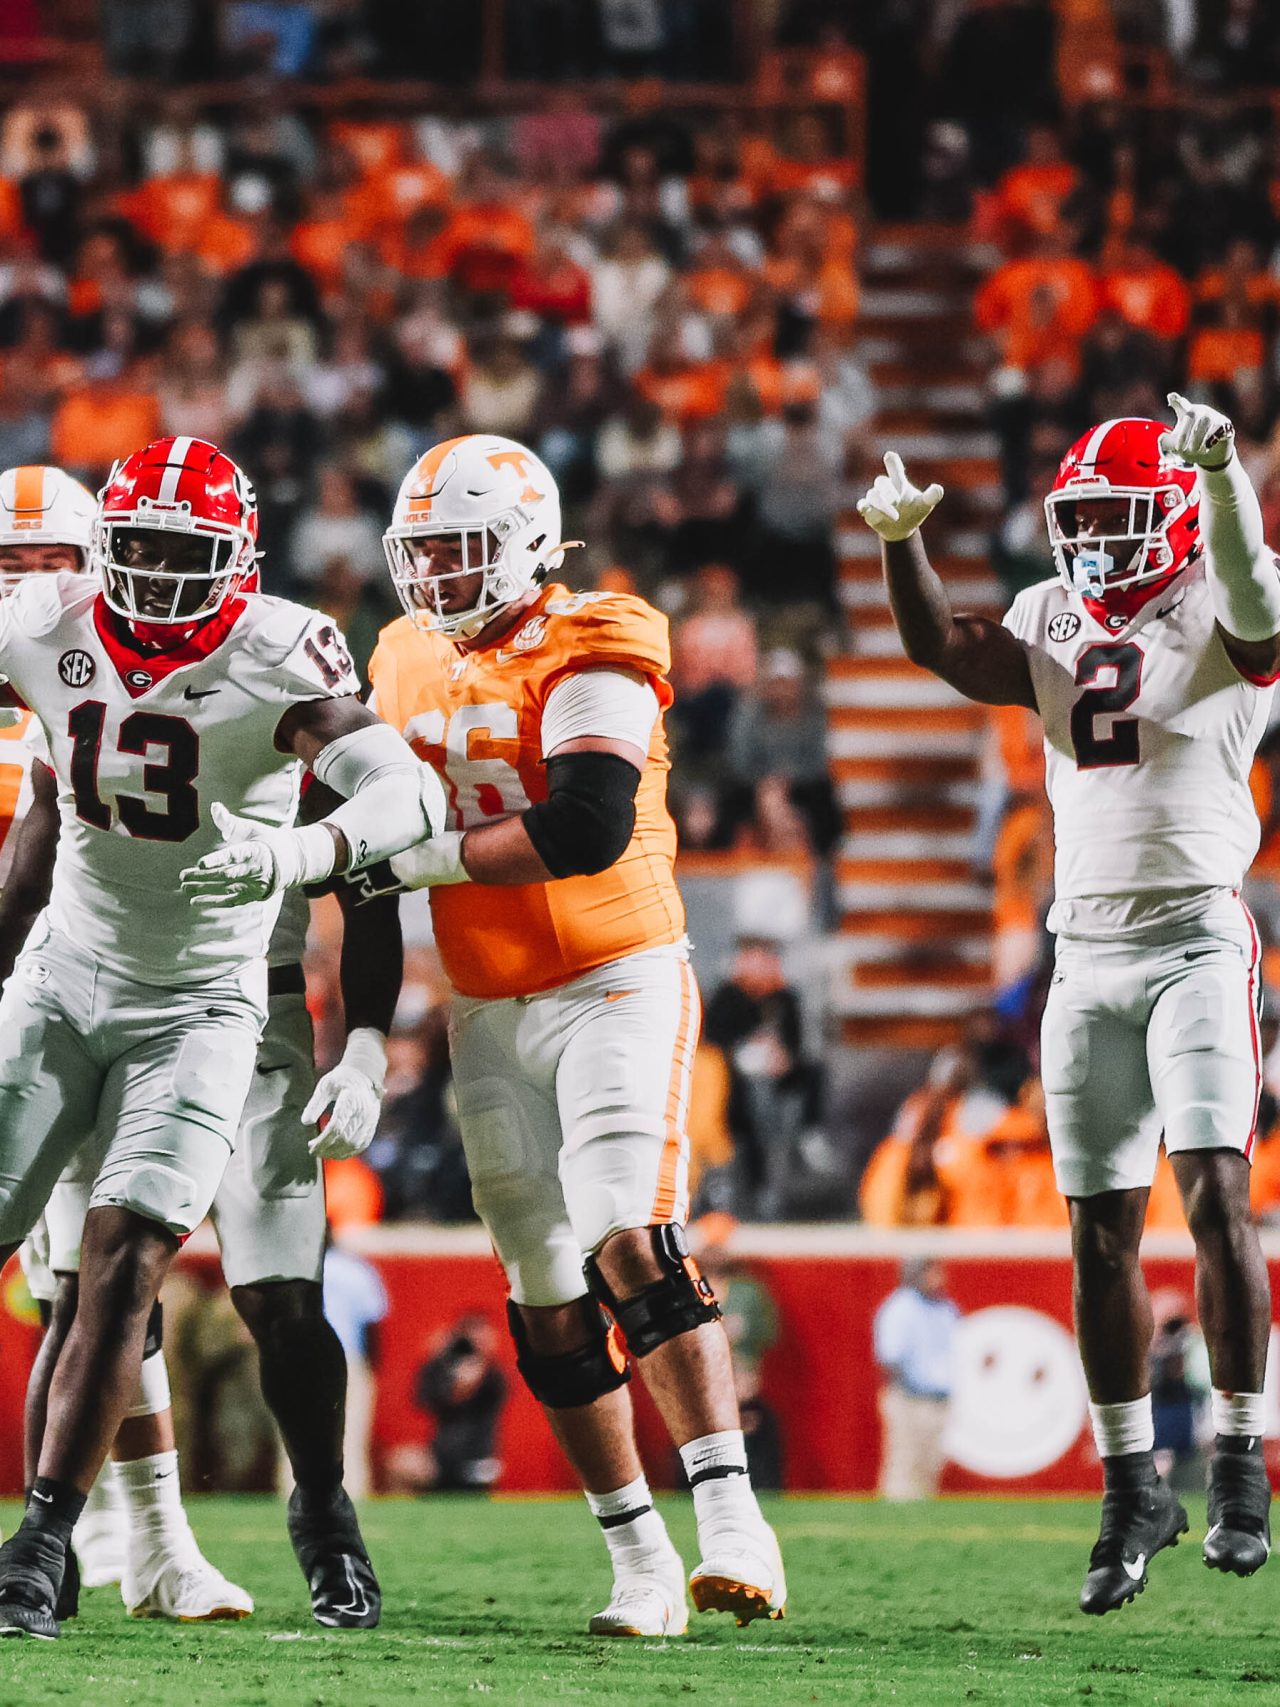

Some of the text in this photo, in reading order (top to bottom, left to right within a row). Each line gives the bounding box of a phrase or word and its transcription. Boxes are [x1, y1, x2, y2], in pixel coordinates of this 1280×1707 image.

[486, 452, 546, 504] T
[1049, 613, 1081, 642] SEC
[1106, 615, 1127, 629] G
[59, 650, 96, 688] SEC
[127, 670, 152, 687] G
[304, 626, 352, 689] 13
[1070, 642, 1145, 771] 2
[67, 699, 200, 843] 13
